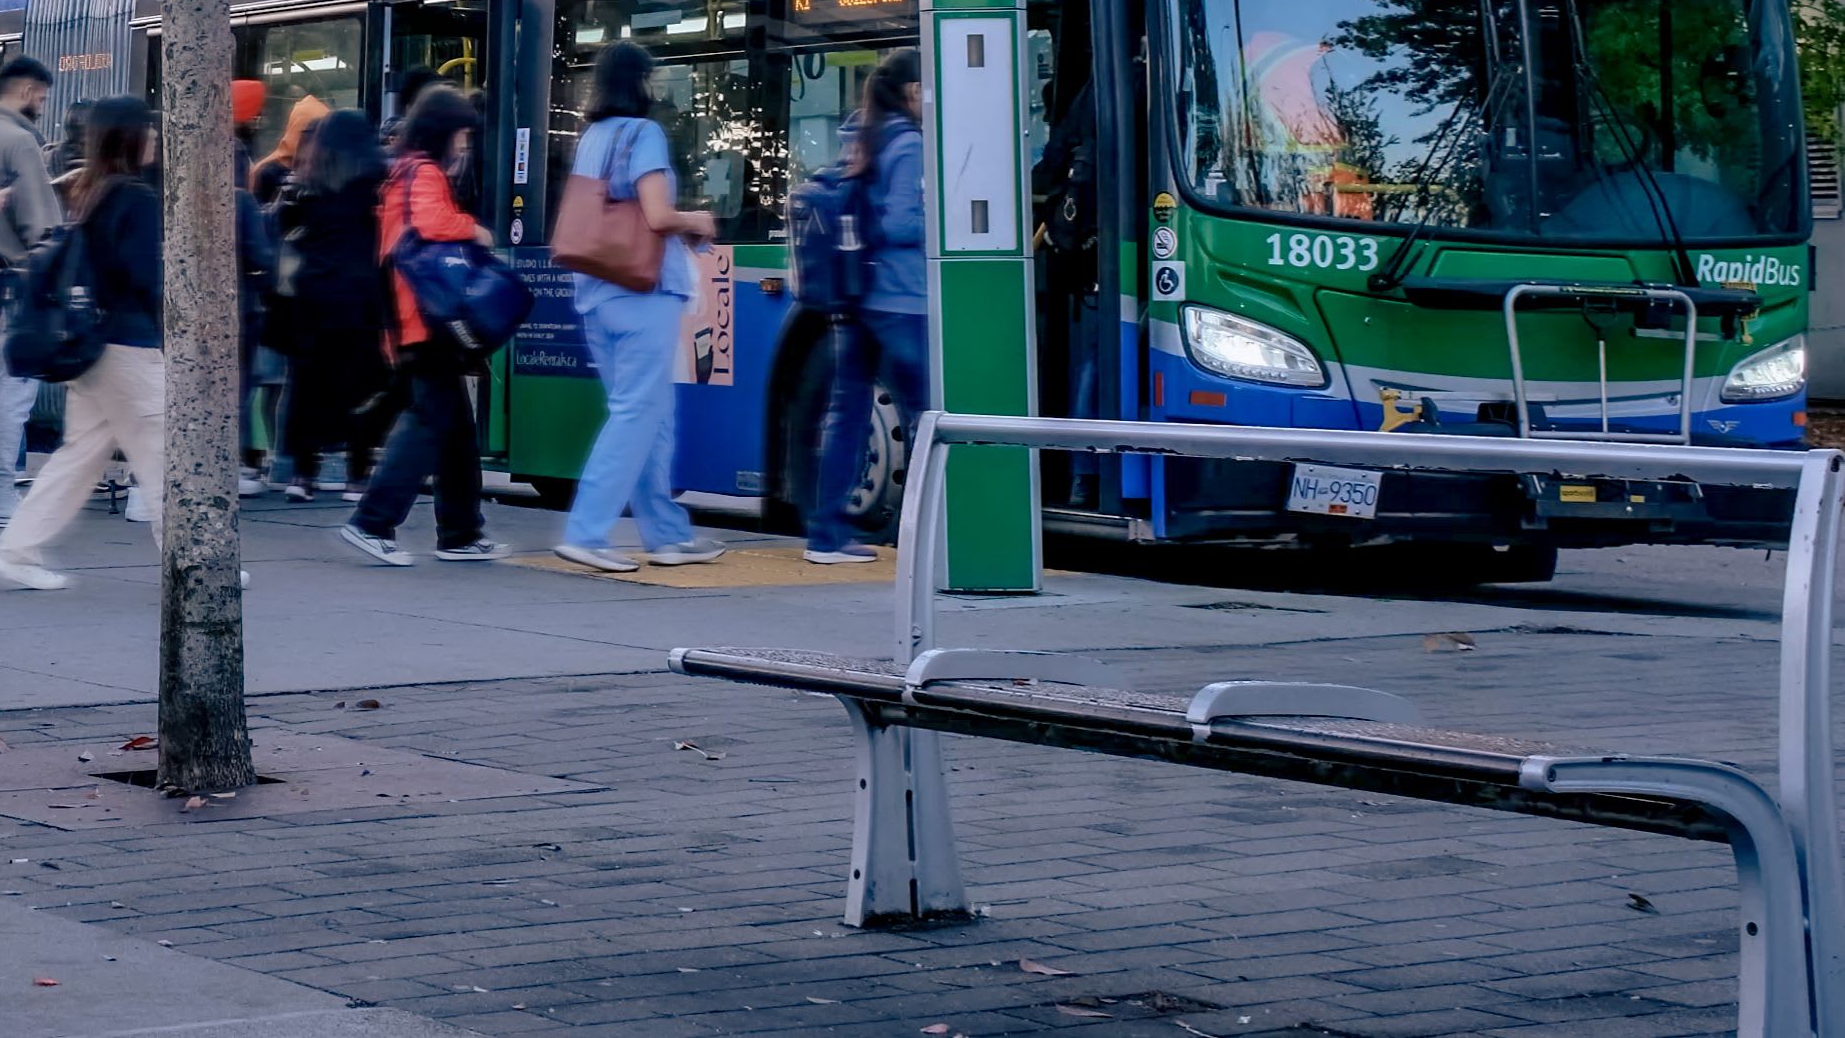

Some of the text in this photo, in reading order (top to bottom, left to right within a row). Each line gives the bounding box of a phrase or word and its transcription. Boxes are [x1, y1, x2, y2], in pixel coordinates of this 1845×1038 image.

[1266, 233, 1378, 271] 18033
[1696, 254, 1800, 286] RapidBus
[711, 255, 730, 375] Locale
[1294, 476, 1318, 500] NH
[1329, 481, 1377, 506] 9350
